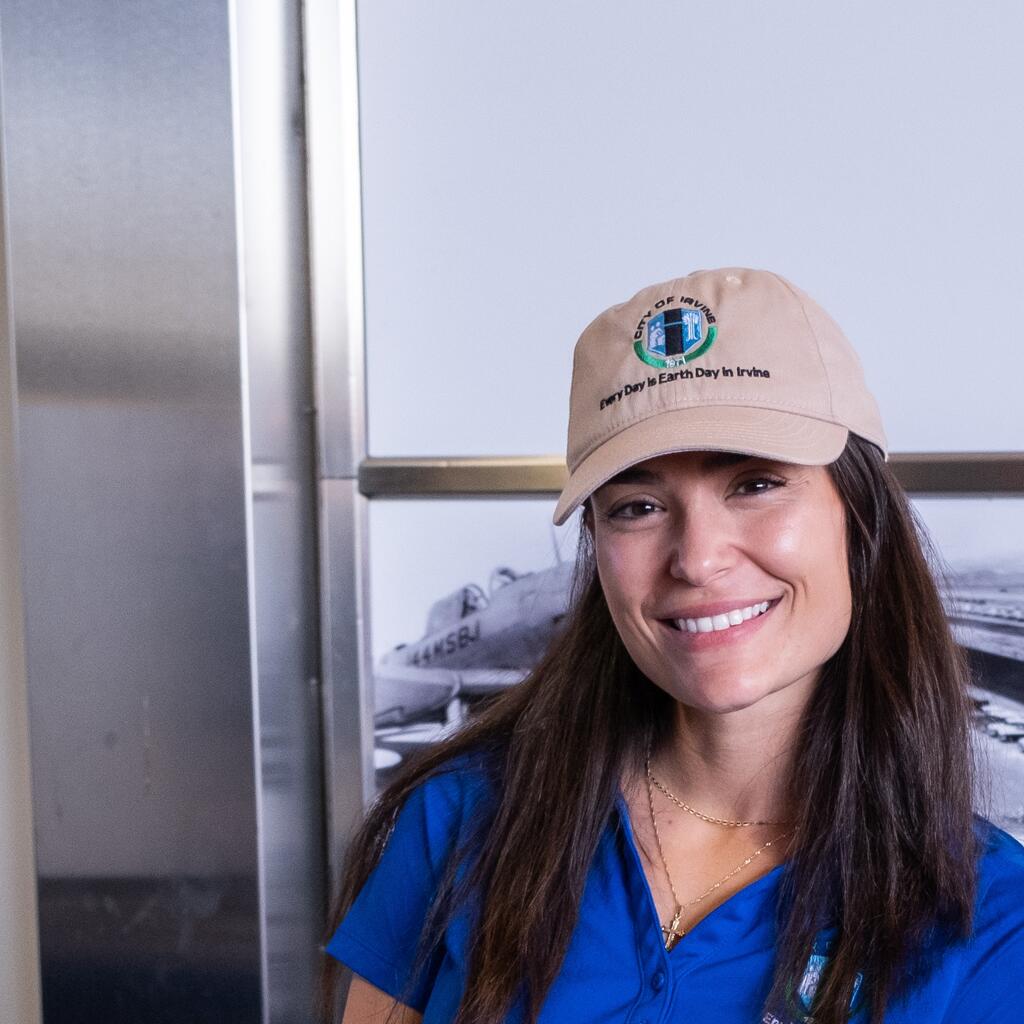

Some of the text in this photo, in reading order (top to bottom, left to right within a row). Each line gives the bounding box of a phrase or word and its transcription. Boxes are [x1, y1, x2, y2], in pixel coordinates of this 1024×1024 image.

[634, 296, 716, 339] CITY OF IRVINE
[599, 389, 623, 411] Every
[624, 381, 645, 396] Day
[658, 369, 694, 384] Earth
[695, 367, 720, 380] Day
[737, 366, 771, 379] Irvine
